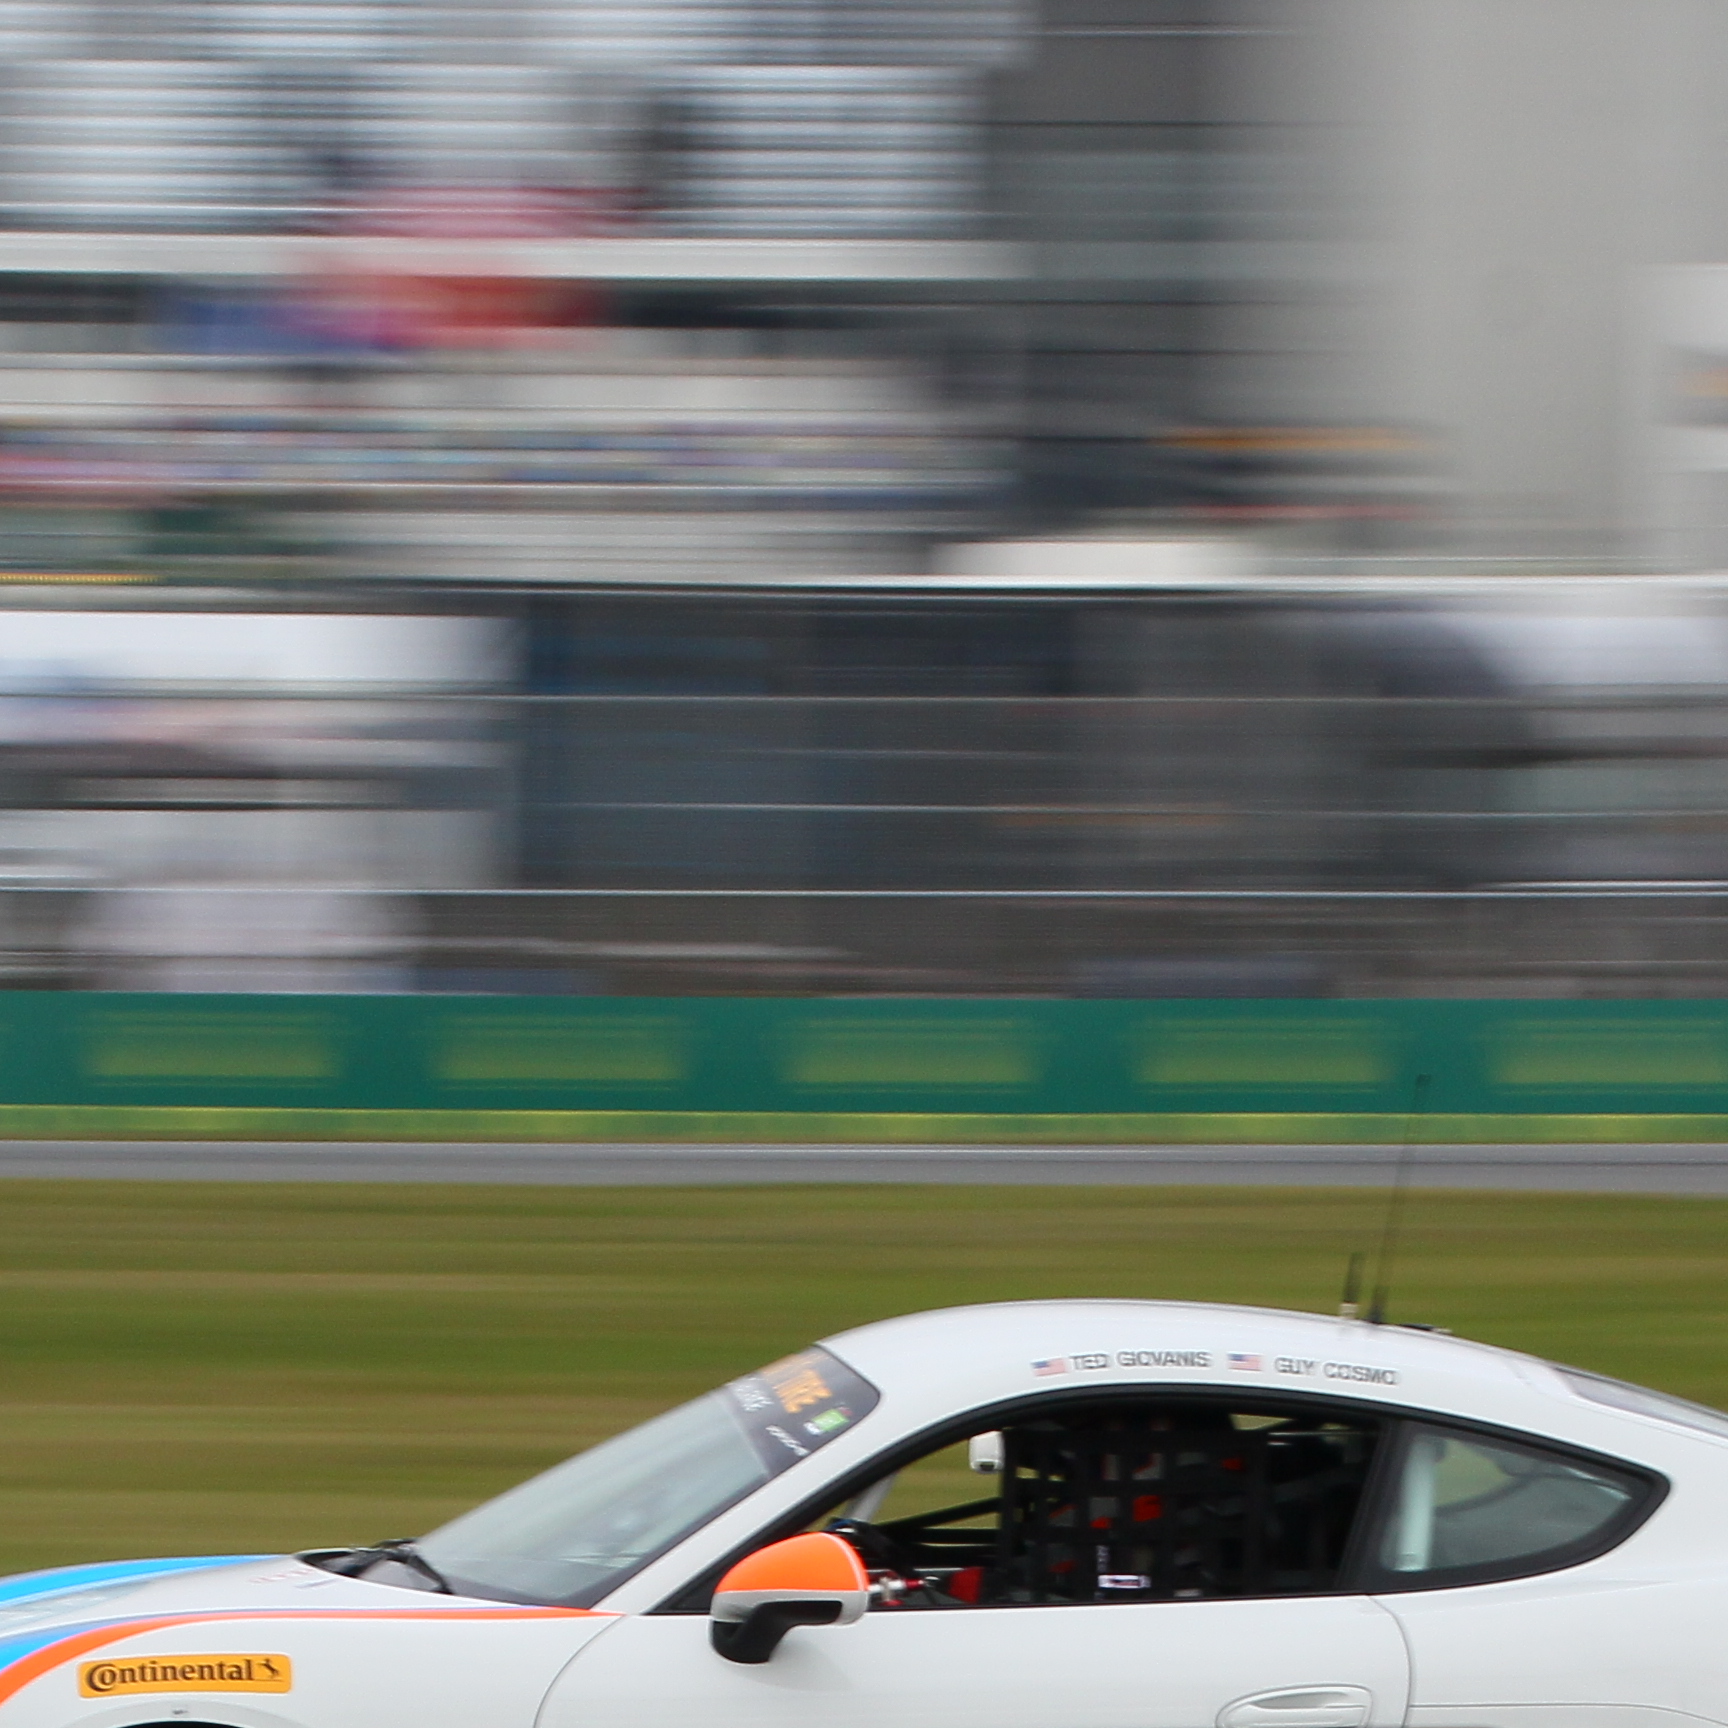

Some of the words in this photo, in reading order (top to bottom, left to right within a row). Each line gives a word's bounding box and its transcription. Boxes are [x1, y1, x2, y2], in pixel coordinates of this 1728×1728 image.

[1069, 1354, 1109, 1371] TED
[1274, 1356, 1317, 1375] GUY
[1323, 1361, 1399, 1386] COSMO
[86, 1658, 255, 1692] Continental
